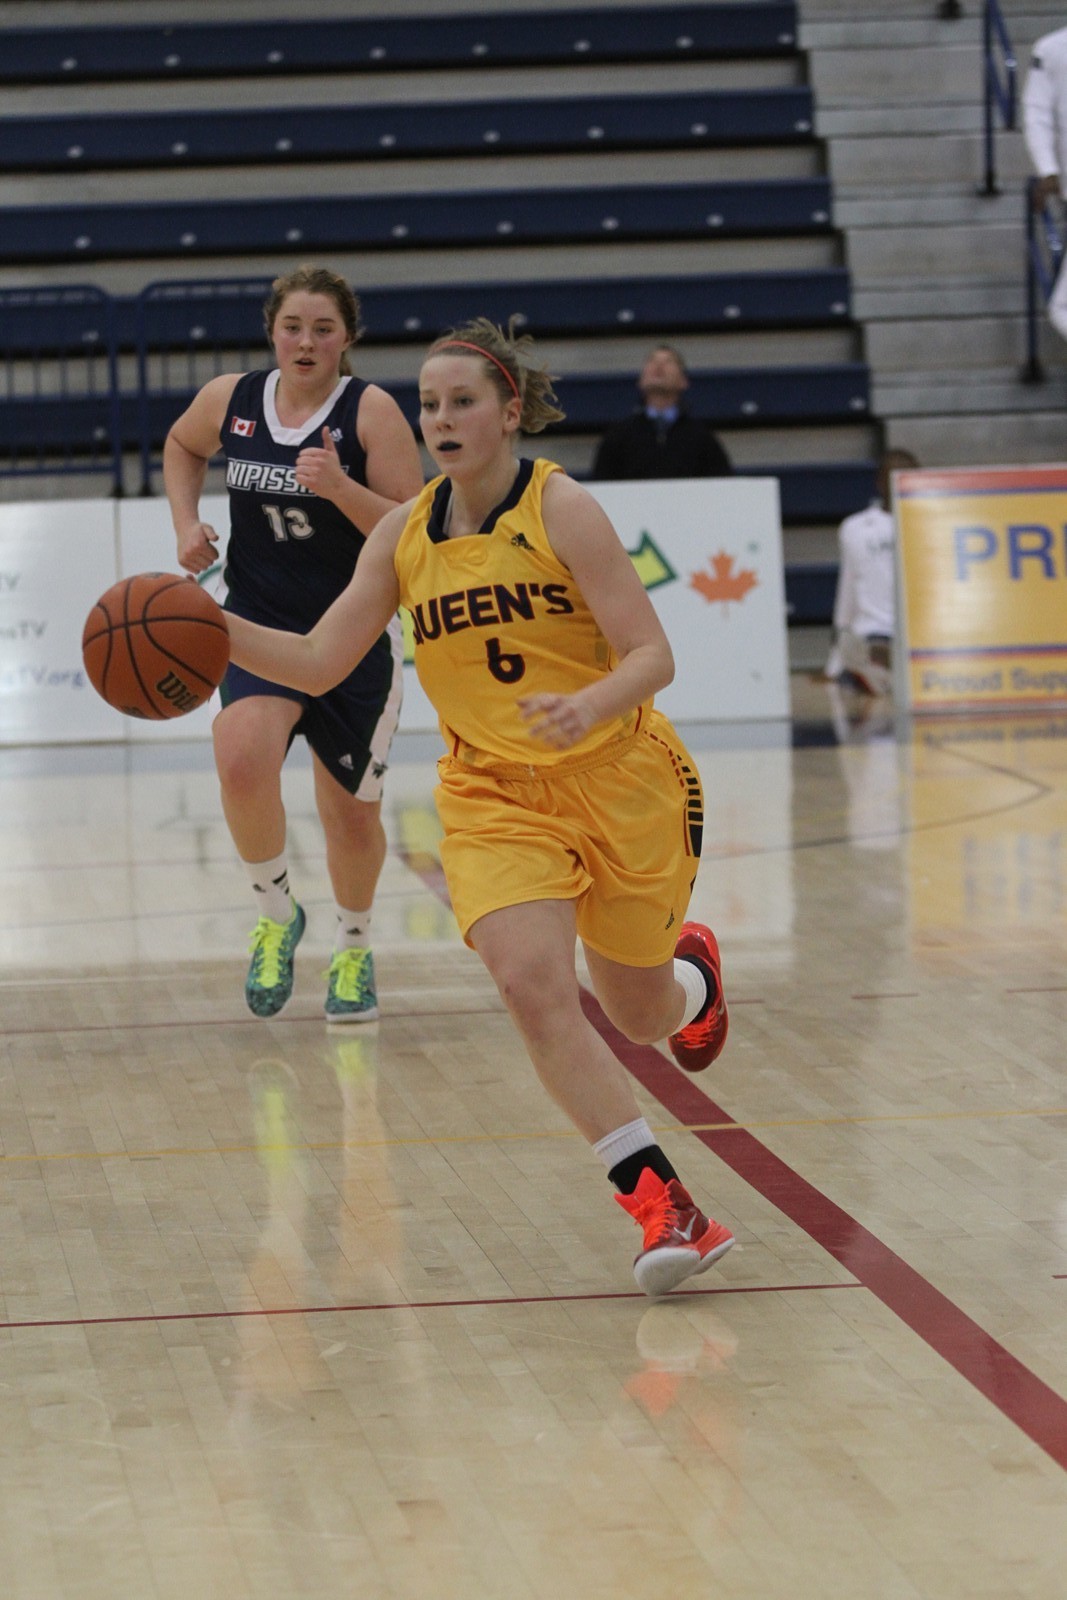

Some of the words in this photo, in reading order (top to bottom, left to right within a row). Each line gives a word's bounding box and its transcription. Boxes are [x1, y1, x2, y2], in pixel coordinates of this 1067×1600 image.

[226, 459, 349, 496] NIPISS
[262, 504, 316, 542] 13
[954, 523, 1067, 581] PR
[485, 637, 526, 684] 6
